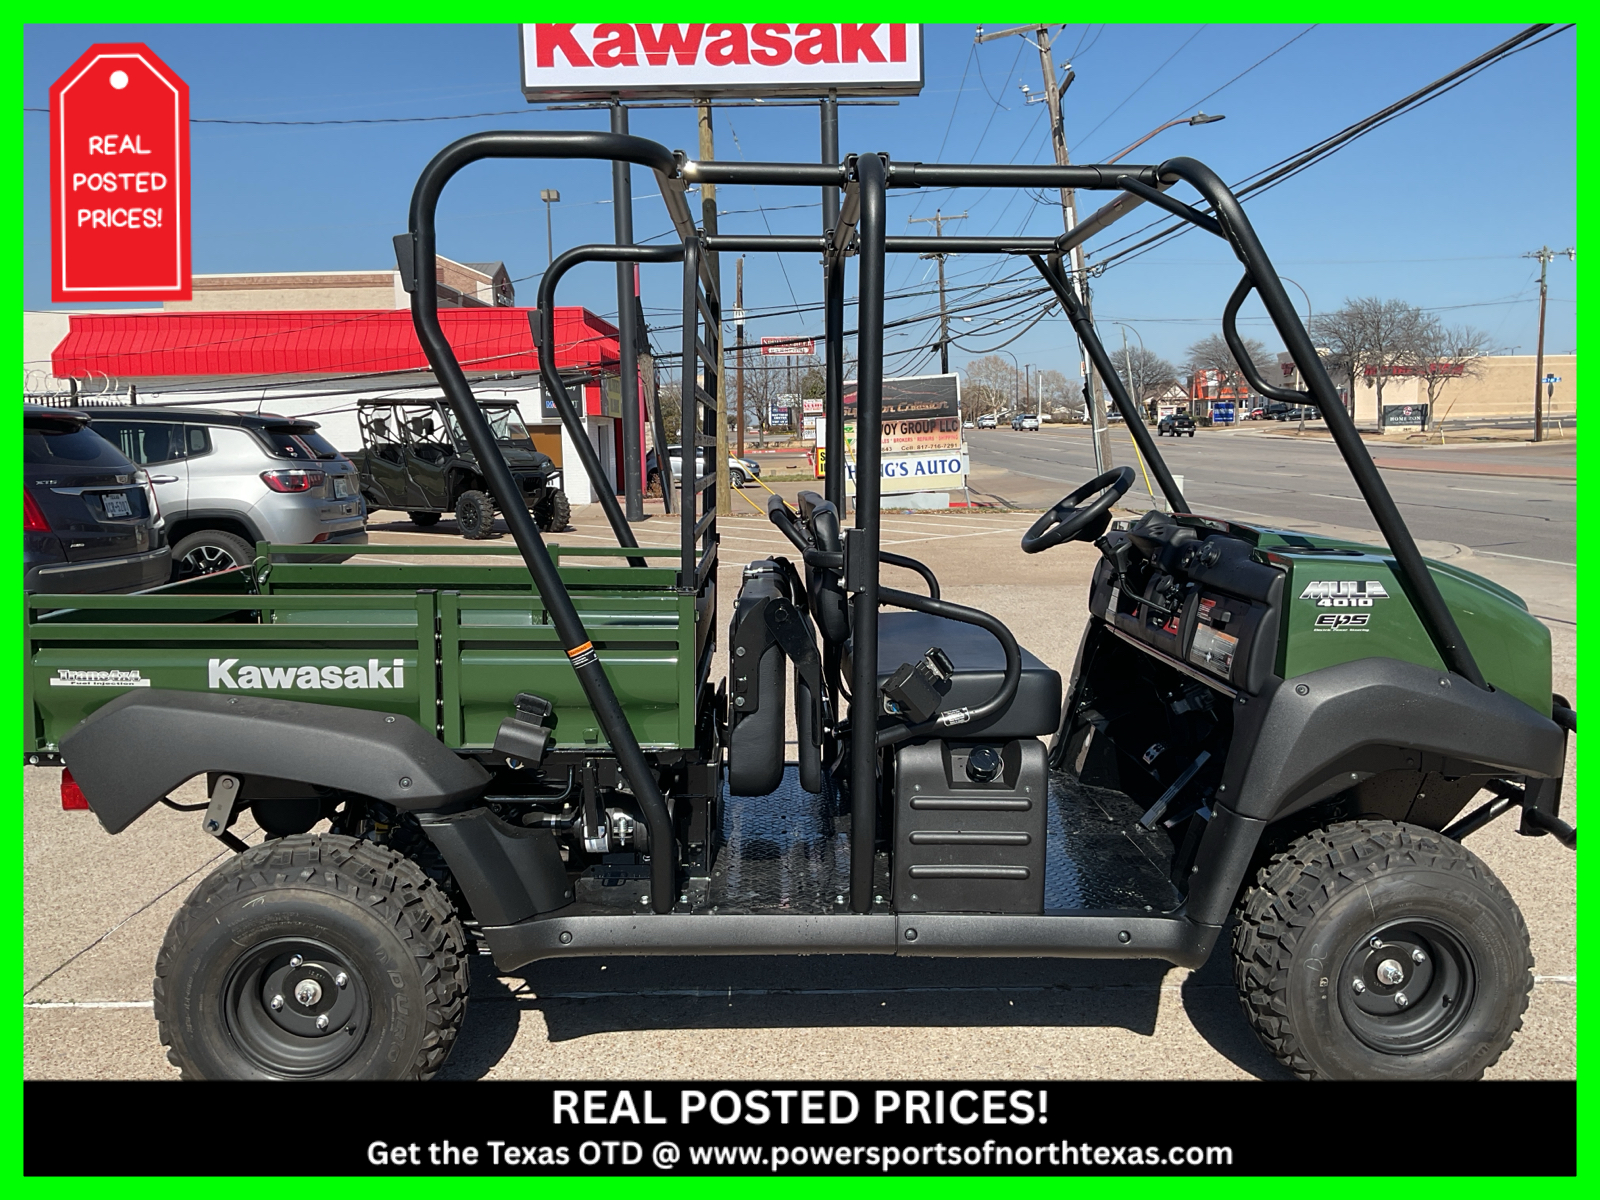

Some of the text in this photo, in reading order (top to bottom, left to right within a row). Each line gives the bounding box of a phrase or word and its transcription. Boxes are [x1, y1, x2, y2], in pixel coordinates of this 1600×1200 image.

[901, 420, 936, 434] GROUP
[940, 419, 958, 432] LLC
[915, 458, 961, 476] AUTO
[1299, 580, 1390, 599] MULE
[1317, 598, 1374, 608] 4010
[57, 669, 141, 681] Trans4x4
[208, 658, 405, 690] Kawasaki
